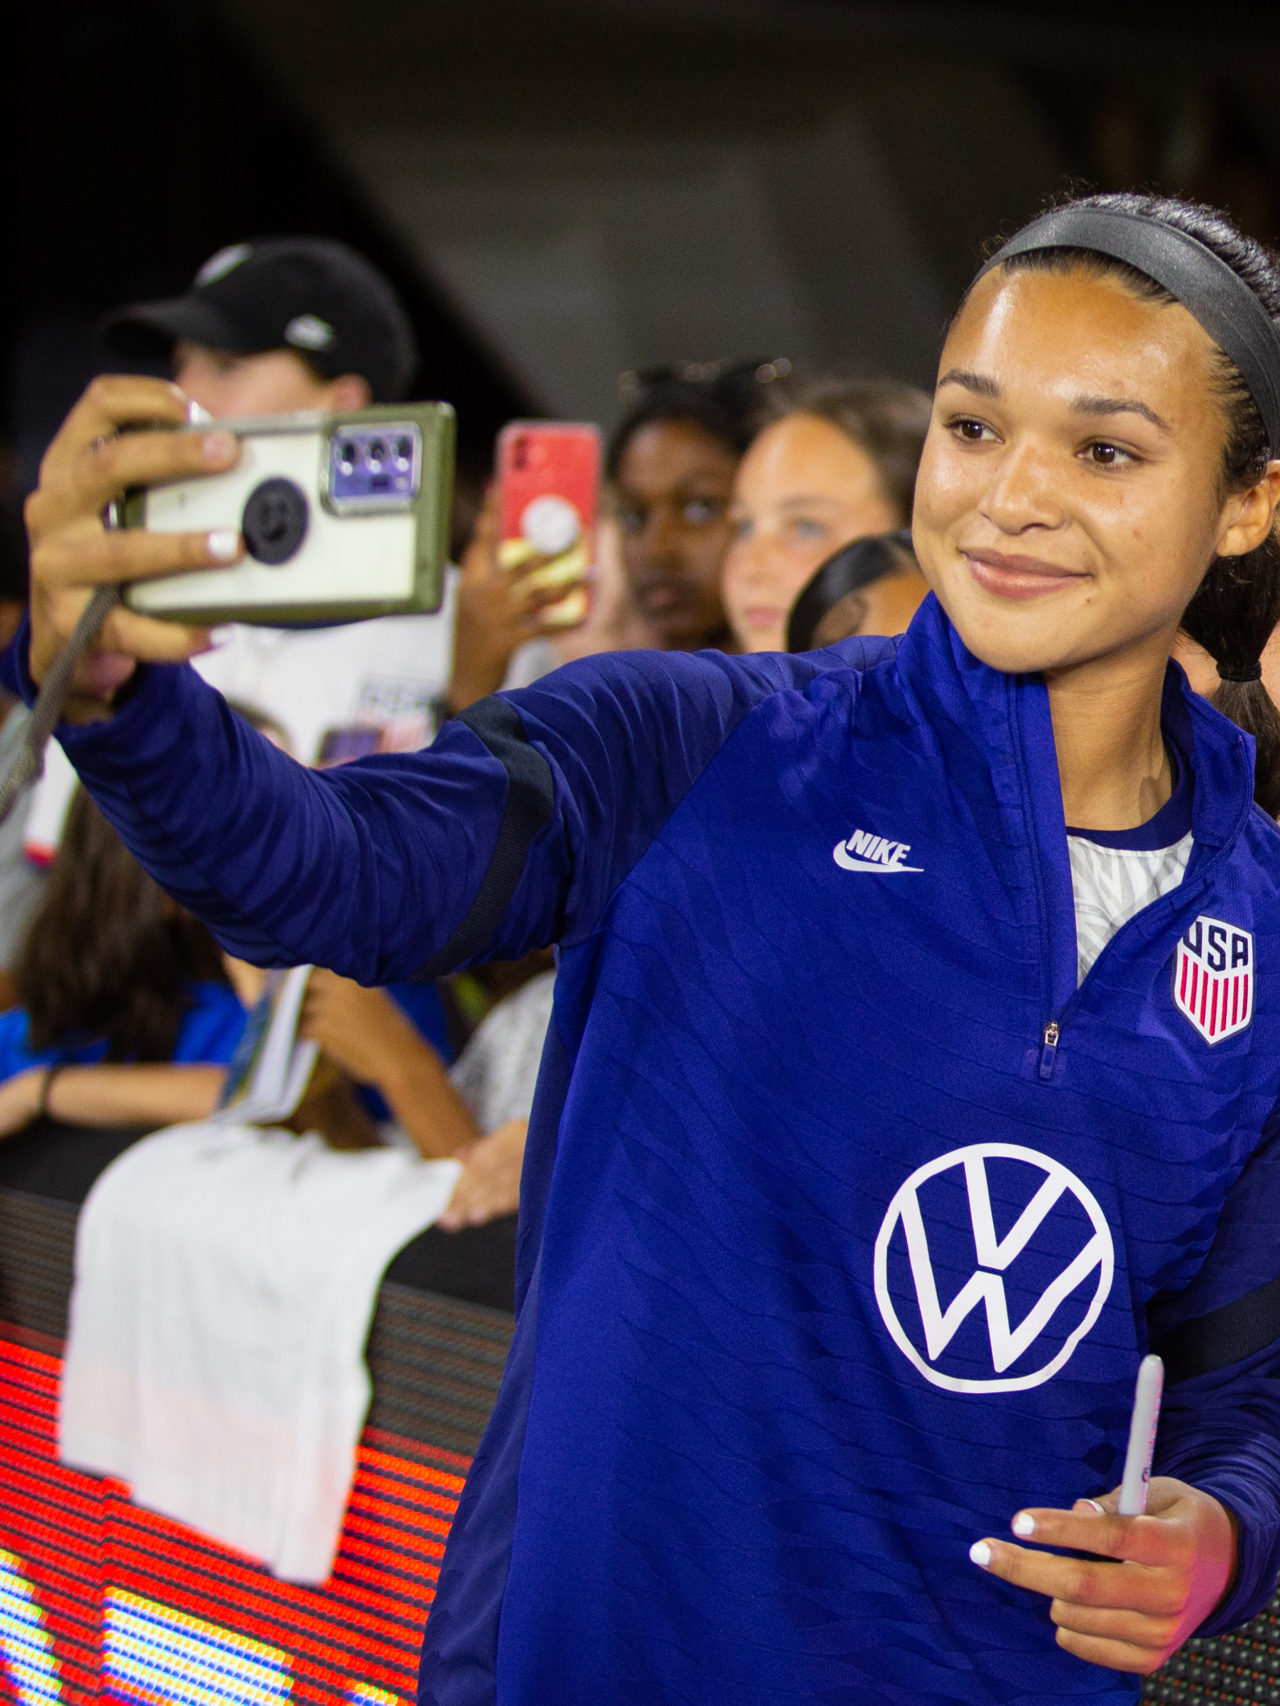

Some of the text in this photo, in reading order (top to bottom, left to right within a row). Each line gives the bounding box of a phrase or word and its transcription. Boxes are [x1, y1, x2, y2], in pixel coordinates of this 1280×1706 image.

[846, 829, 911, 867] NIKE
[1182, 920, 1248, 972] USA
[882, 1143, 1113, 1380] VW
